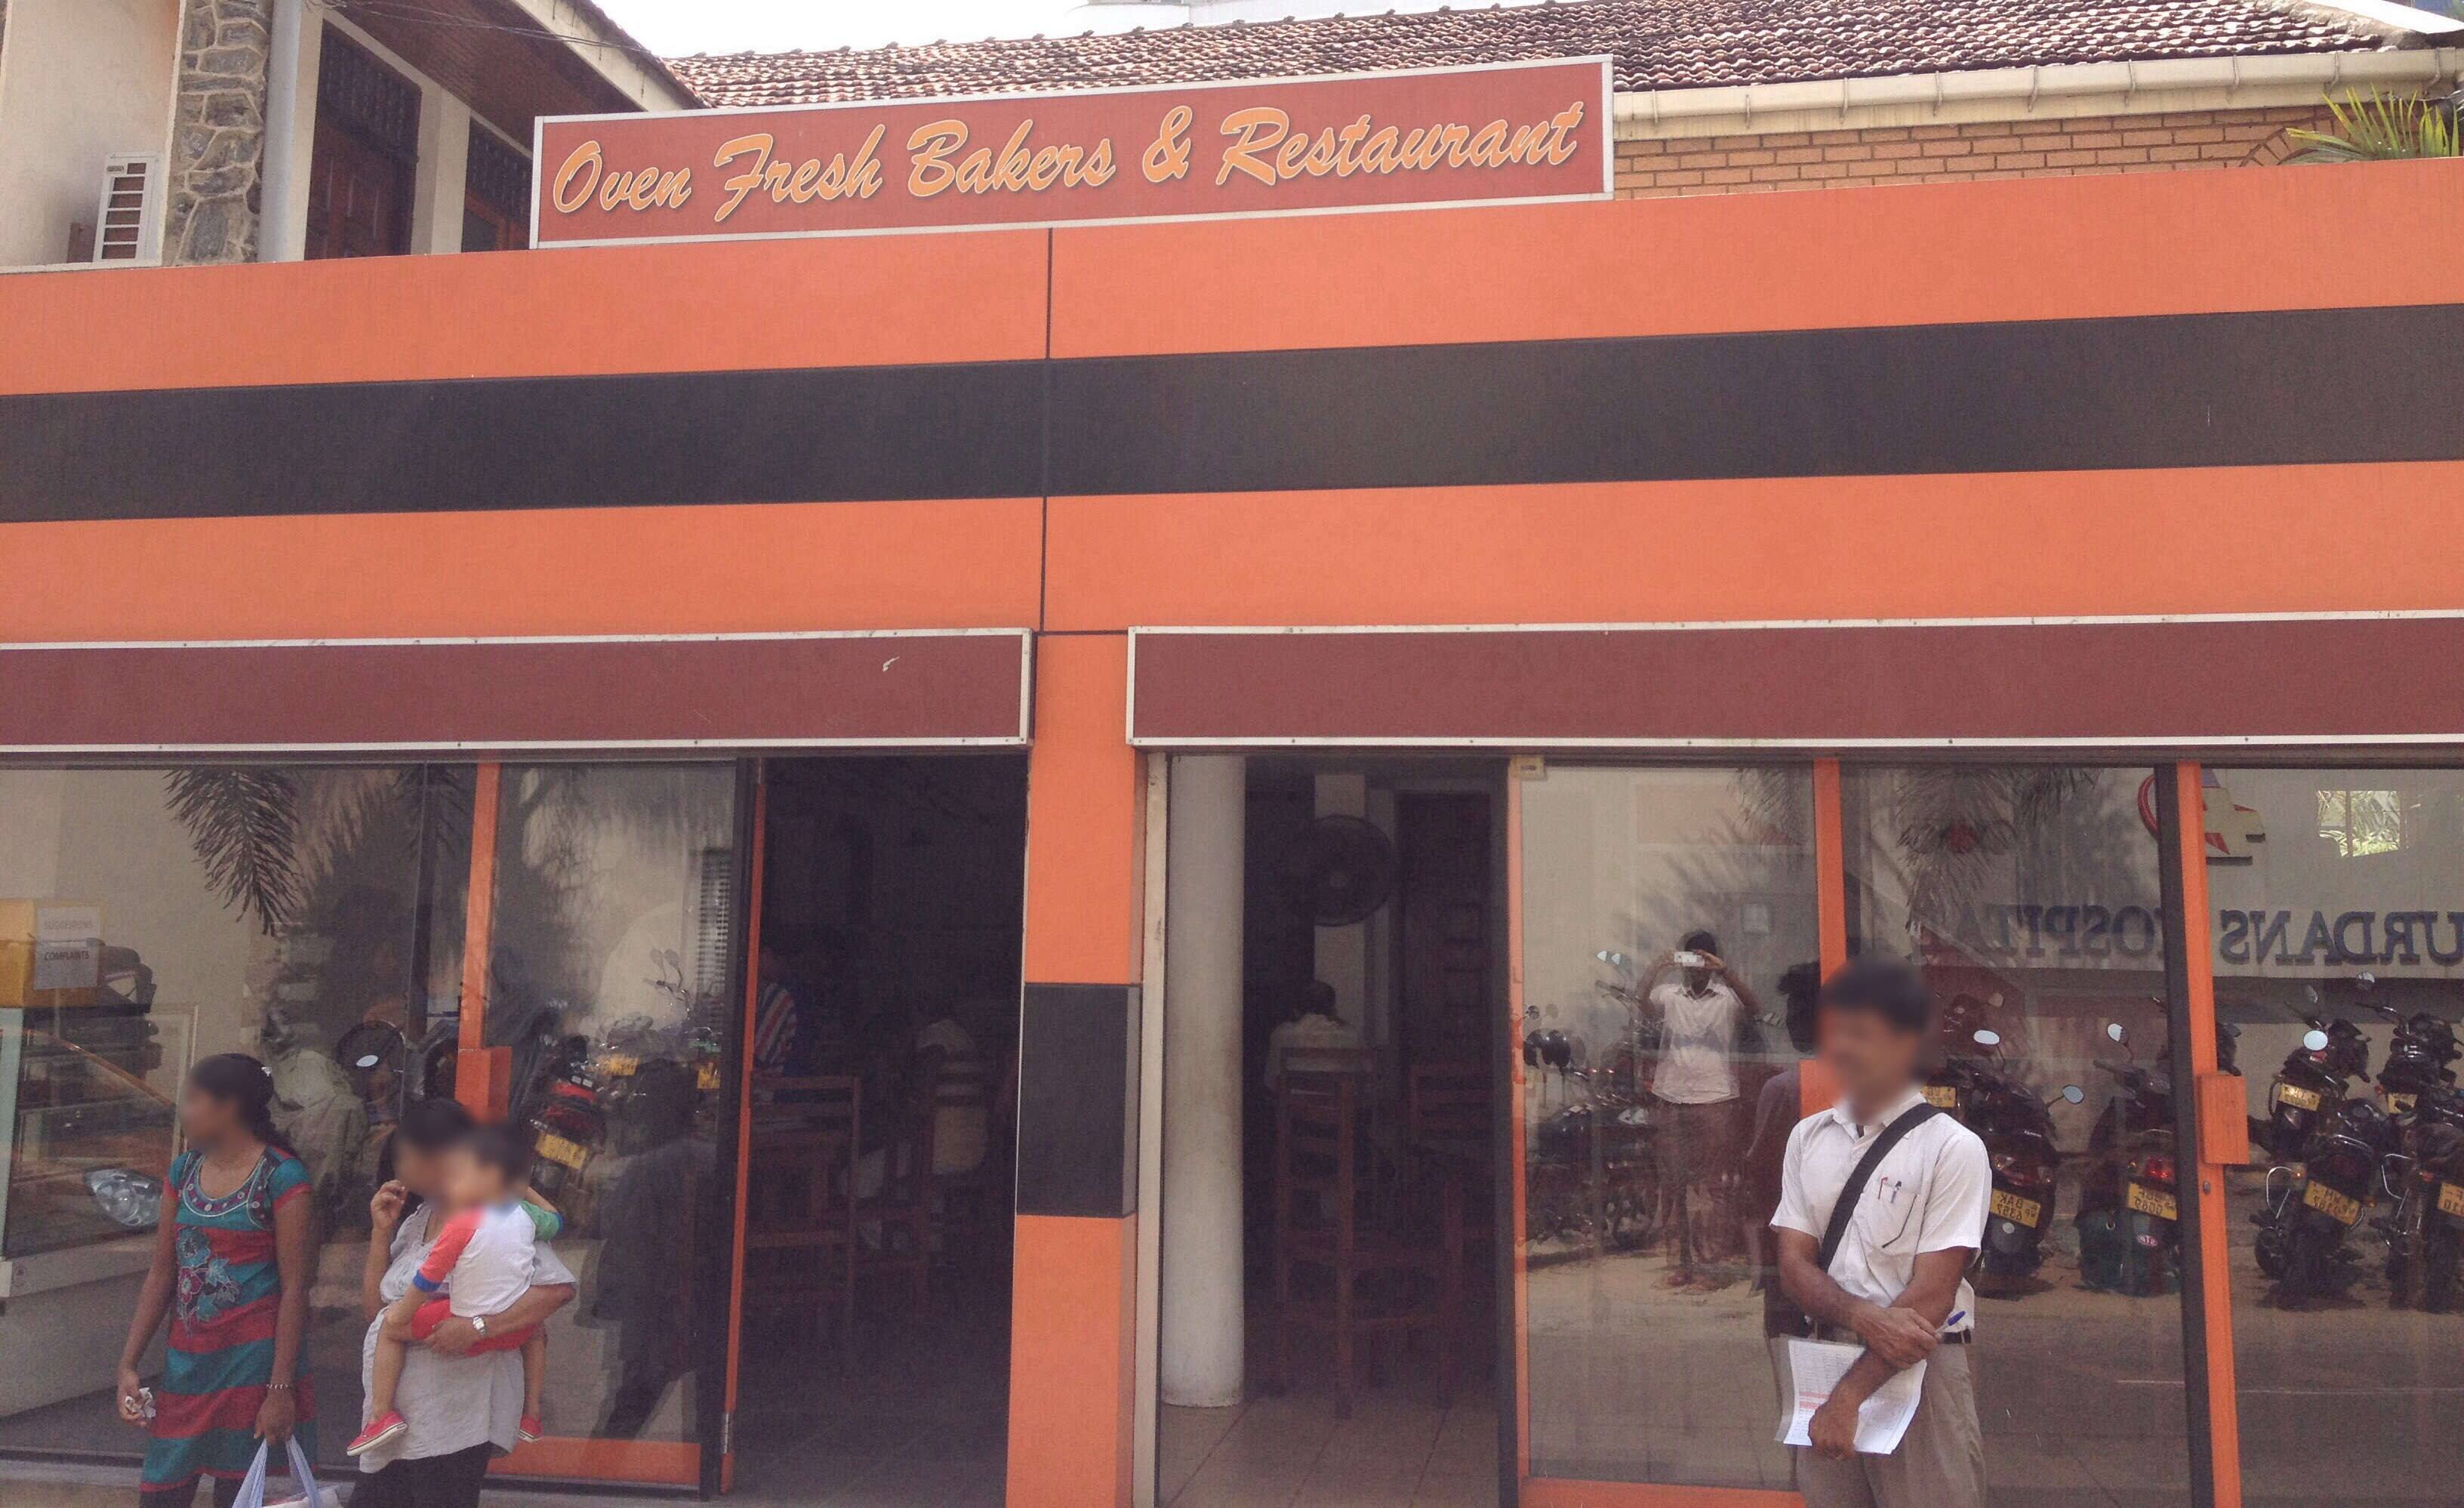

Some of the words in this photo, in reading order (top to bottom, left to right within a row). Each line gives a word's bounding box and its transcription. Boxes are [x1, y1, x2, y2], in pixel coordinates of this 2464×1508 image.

[553, 140, 691, 212] Oven
[714, 124, 886, 222] Fresh
[907, 119, 1116, 198] Bakers
[1142, 106, 1193, 183] &
[1215, 101, 1585, 186] Restaurant
[45, 950, 90, 961] COMPLAINTS
